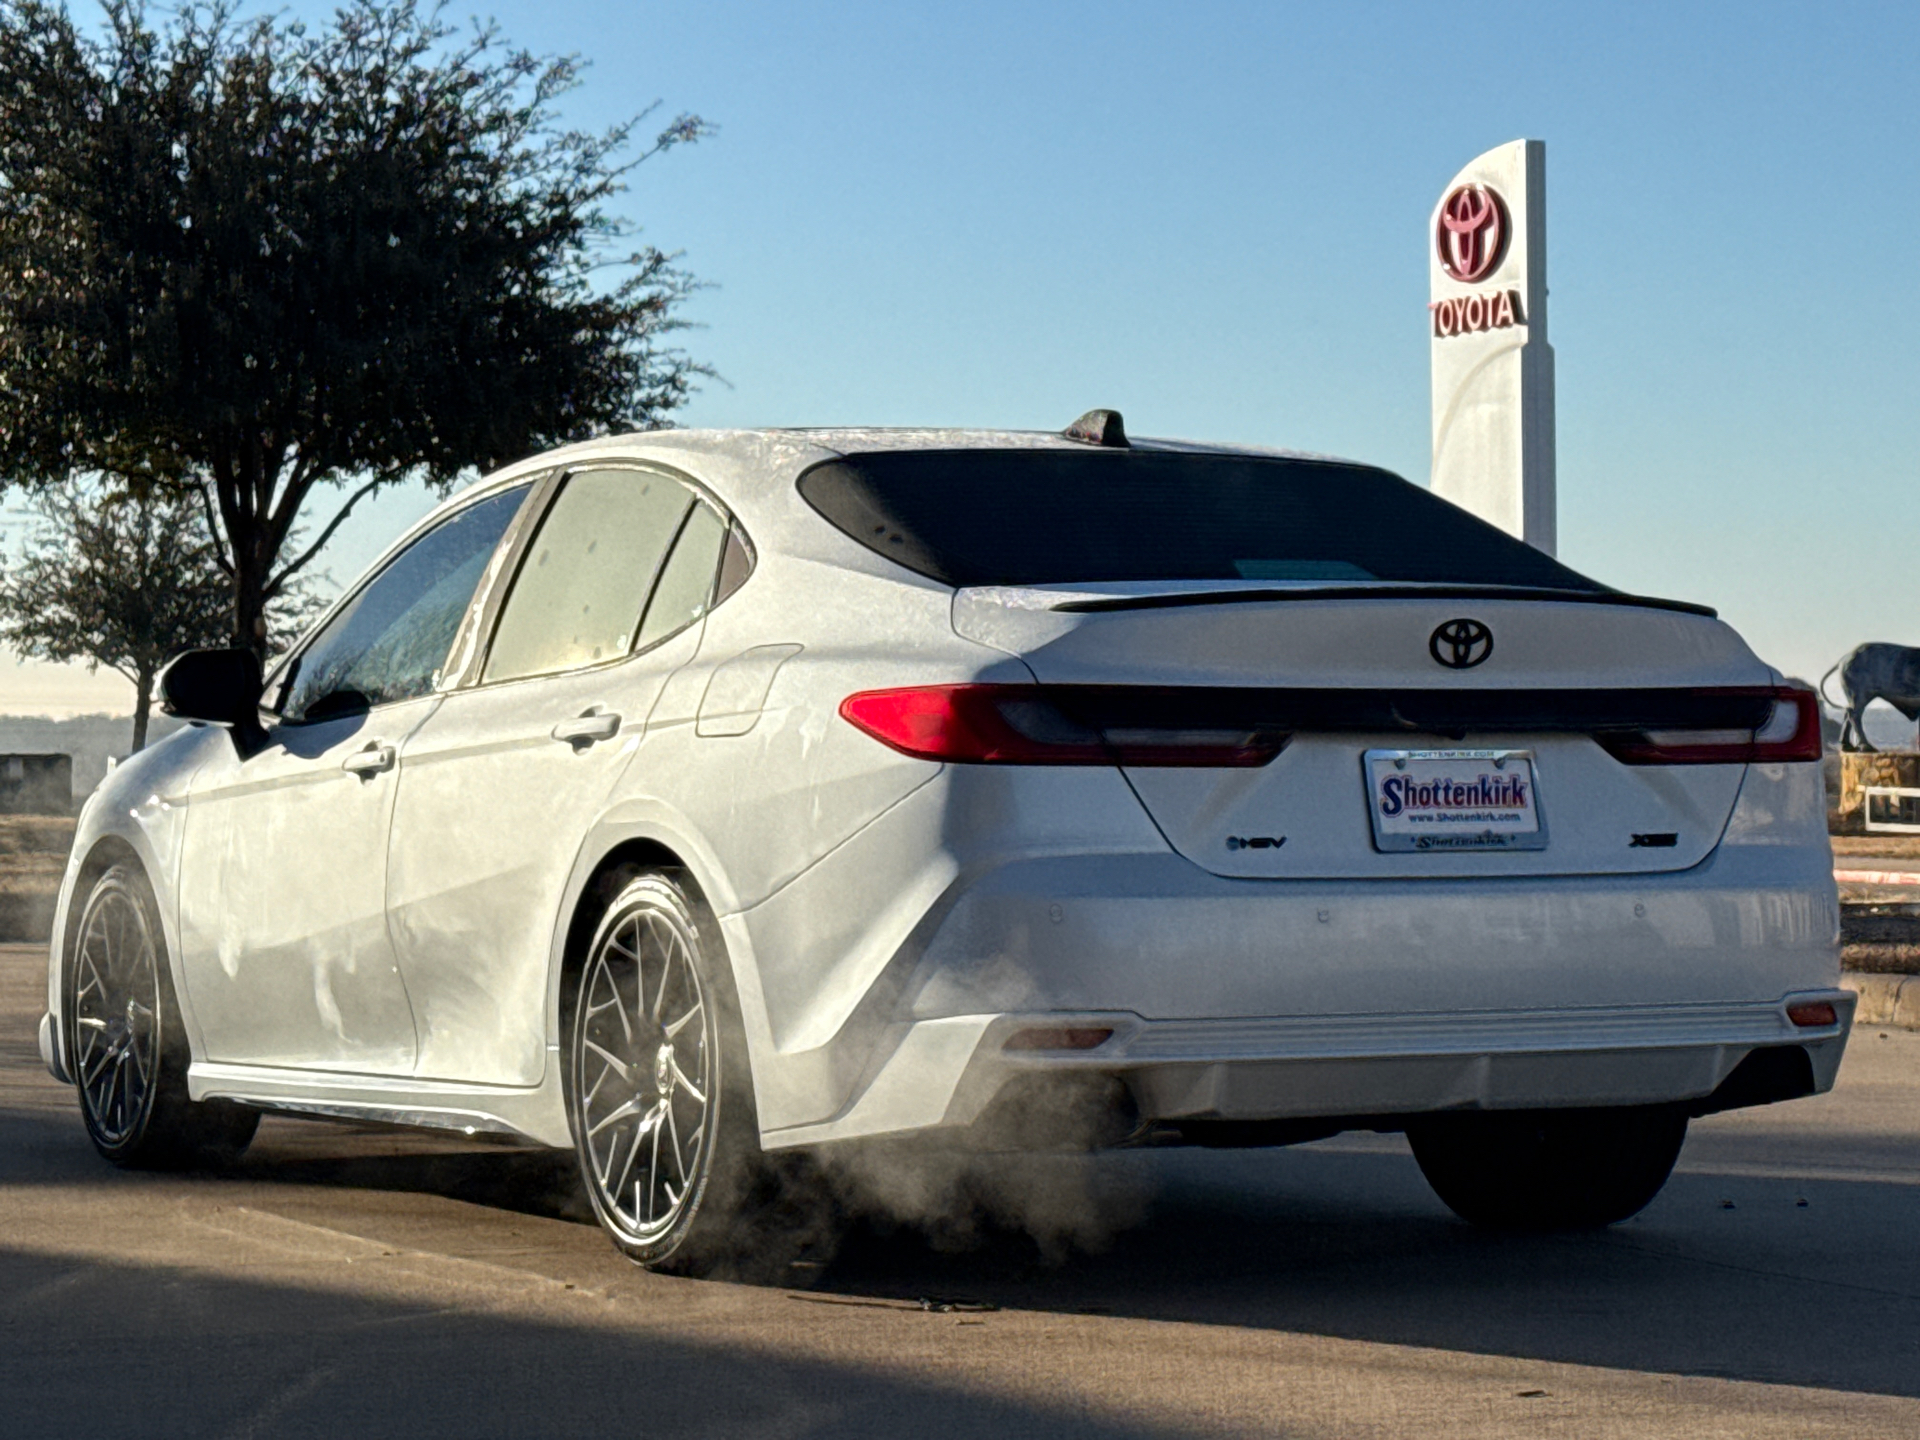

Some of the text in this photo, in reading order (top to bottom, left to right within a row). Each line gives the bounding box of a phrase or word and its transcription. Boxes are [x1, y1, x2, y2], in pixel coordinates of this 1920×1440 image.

[1428, 290, 1517, 336] TOYOTA
[1380, 775, 1527, 817] Shottenkirk
[1408, 811, 1521, 823] www.Shottenkirk.com
